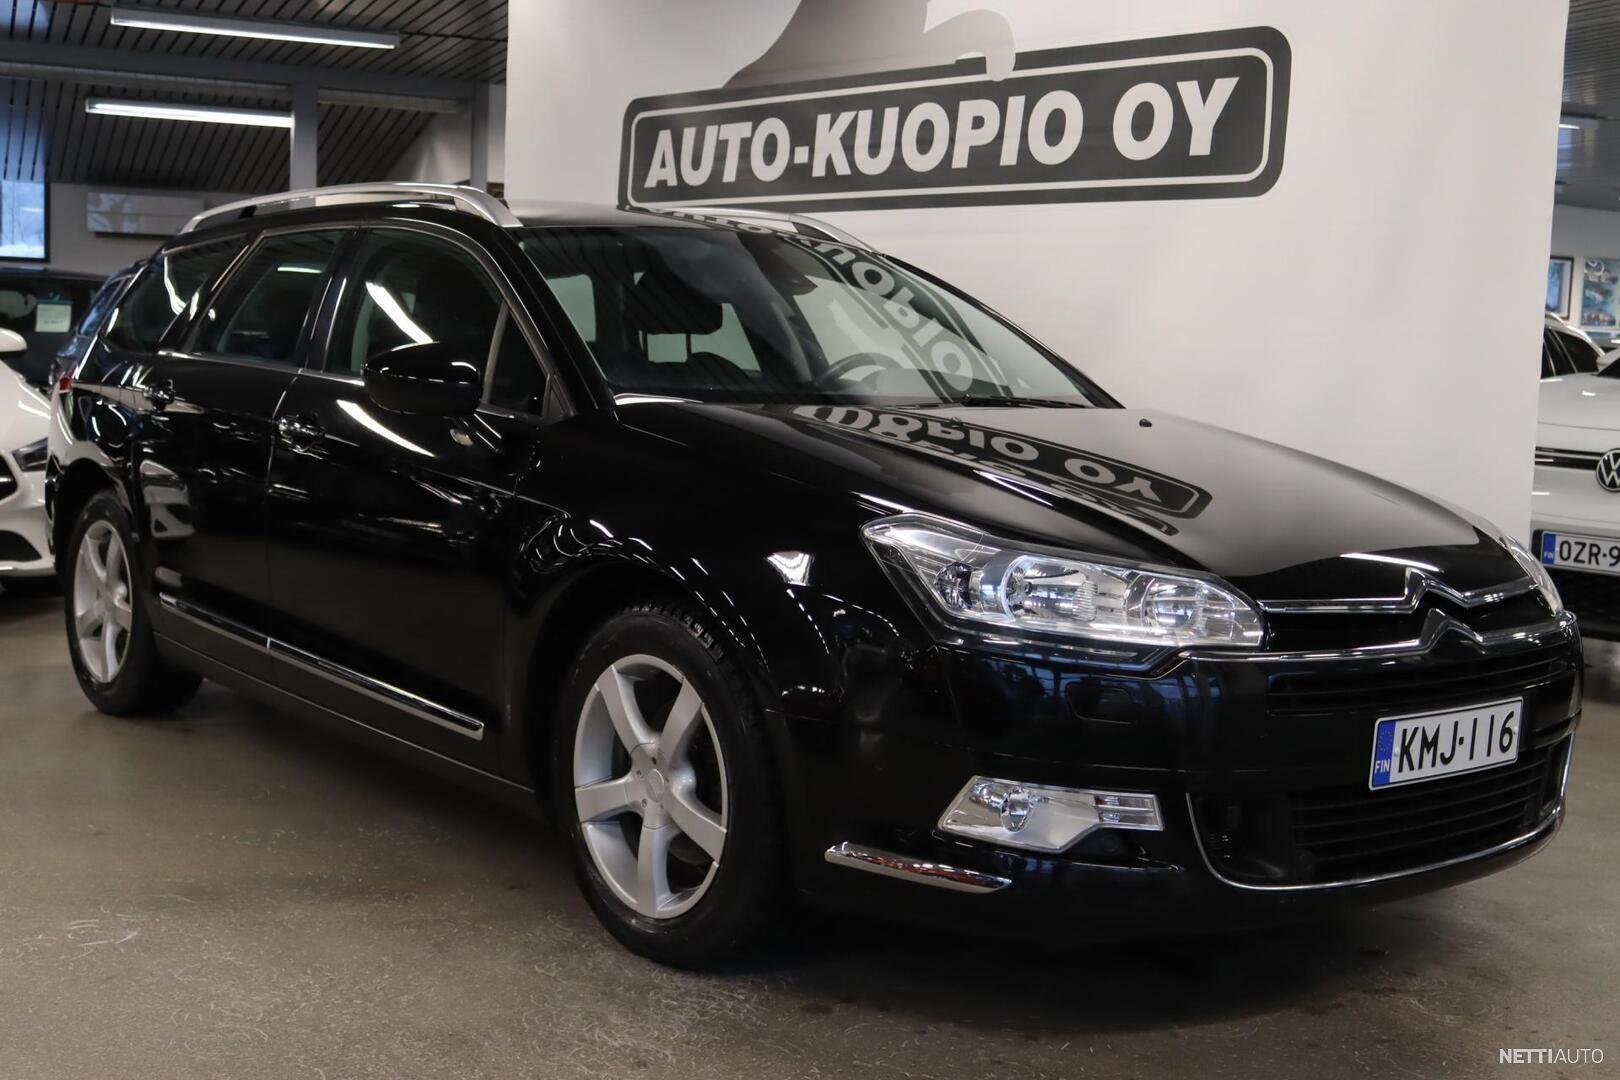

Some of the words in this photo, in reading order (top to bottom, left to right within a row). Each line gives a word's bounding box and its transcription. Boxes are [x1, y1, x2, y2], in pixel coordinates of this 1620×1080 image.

[643, 89, 1084, 189] AUTO-KUOPIO
[1112, 76, 1241, 161] OY
[1374, 758, 1391, 774] FIN
[1398, 710, 1515, 773] KMJ-116
